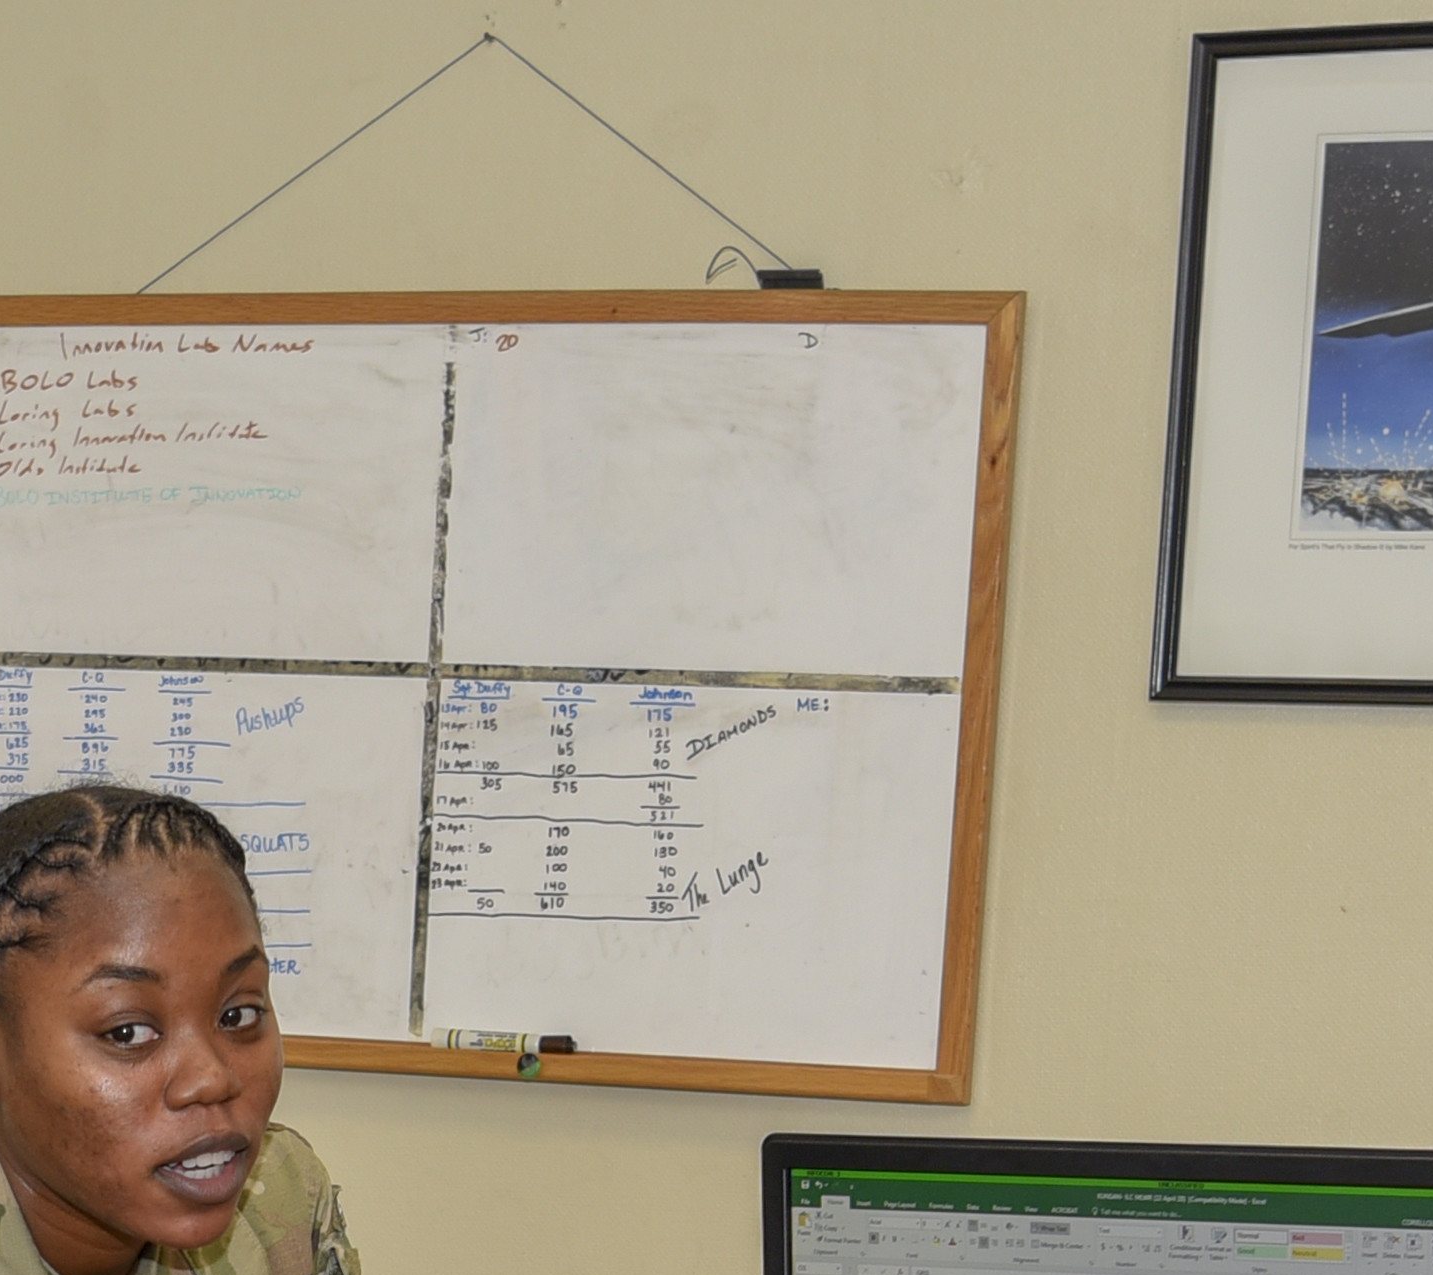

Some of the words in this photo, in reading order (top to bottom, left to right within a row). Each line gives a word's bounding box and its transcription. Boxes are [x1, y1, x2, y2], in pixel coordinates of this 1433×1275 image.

[60, 332, 163, 360] Innovation
[232, 334, 314, 354] Names
[87, 370, 138, 391] Labs
[82, 400, 137, 418] Labs
[452, 682, 472, 699] Sgt
[85, 695, 107, 703] 240
[9, 707, 28, 715] 220
[481, 703, 497, 713] 80
[553, 704, 578, 718] 195
[647, 709, 672, 722] 175
[477, 719, 498, 731] 125
[550, 723, 573, 736] 165
[649, 728, 670, 738] 121
[685, 704, 776, 761] DIAMONDS
[6, 737, 28, 750] 625
[82, 742, 109, 754] 896
[557, 742, 574, 756] 65
[654, 740, 670, 754] 55
[168, 746, 195, 759] 775
[7, 753, 28, 766] 375
[82, 759, 106, 771] 315
[483, 761, 499, 770] 100
[653, 759, 669, 770] 90
[168, 762, 193, 773] 335
[552, 764, 576, 777] 150
[481, 777, 502, 790] 305
[553, 781, 578, 793] 575
[648, 781, 671, 792] 441
[650, 811, 674, 822] 521
[548, 826, 570, 838] 170
[479, 843, 492, 854] 50
[546, 846, 568, 856] 200
[654, 846, 677, 858] 130
[546, 863, 567, 874] 100
[659, 866, 676, 878] 40
[716, 851, 769, 894] Lunge
[544, 882, 566, 891] 140
[657, 883, 674, 893] 20
[477, 898, 494, 910] 50
[540, 898, 564, 910] 610
[650, 901, 674, 913] 350
